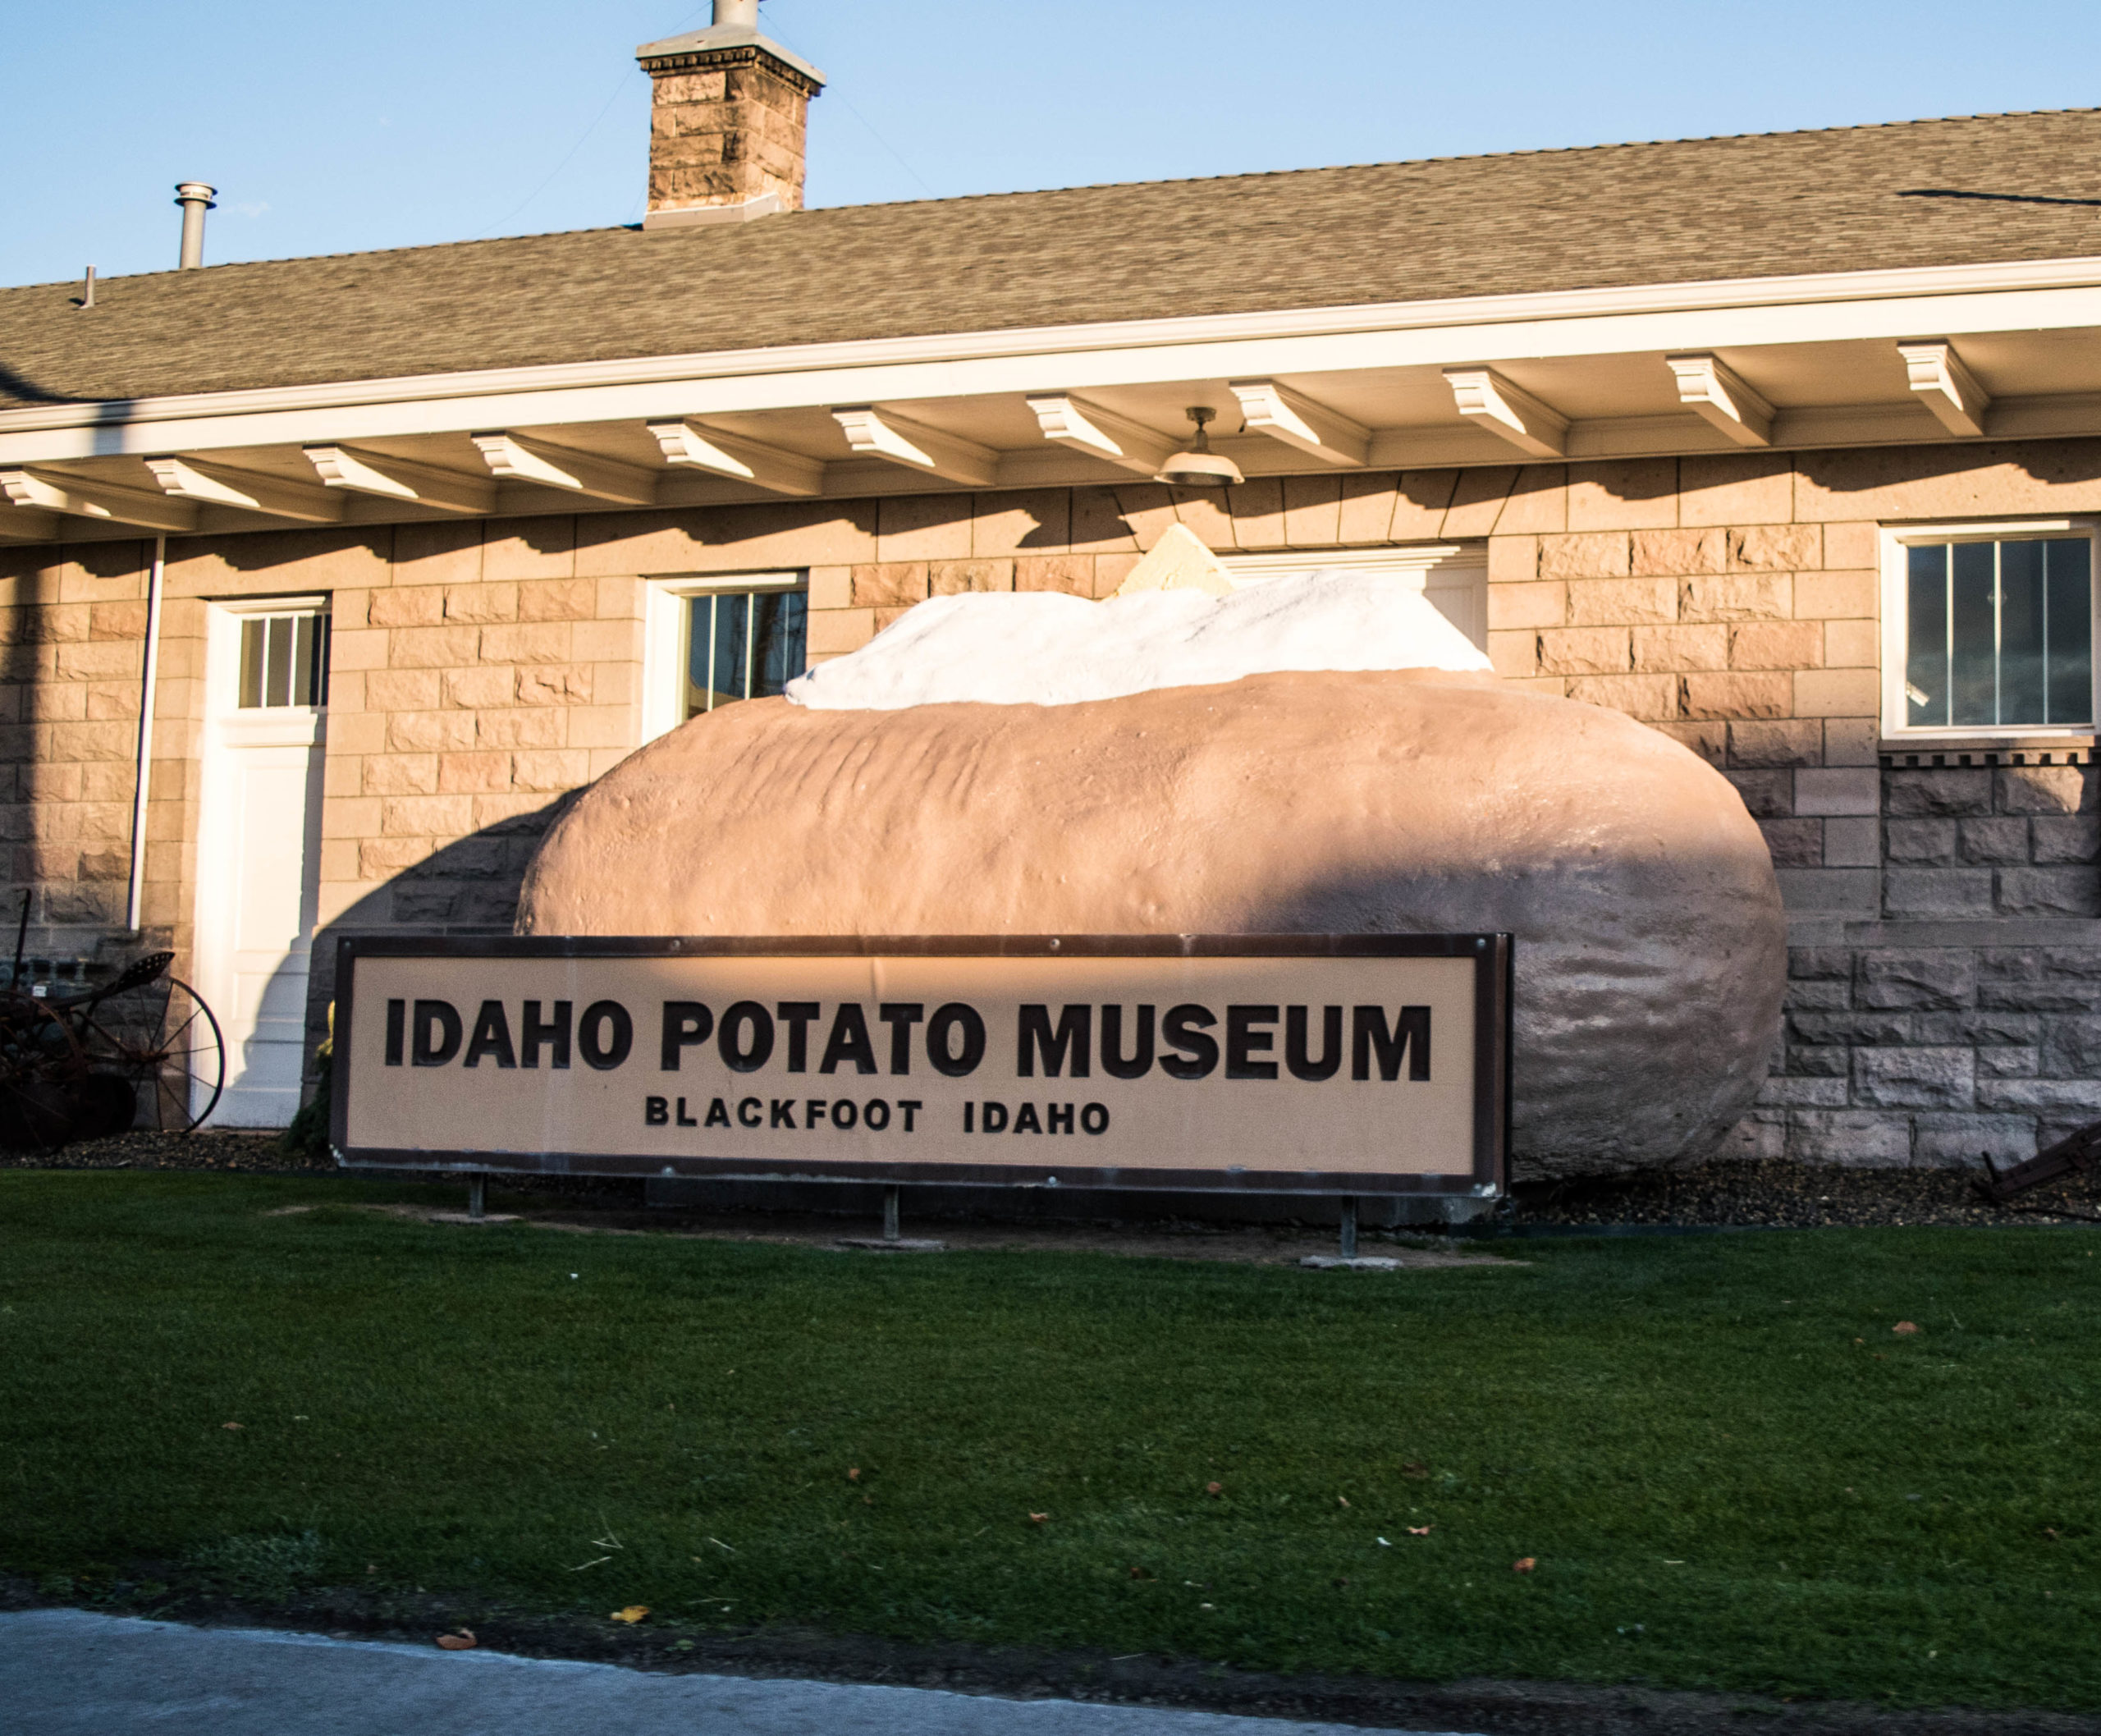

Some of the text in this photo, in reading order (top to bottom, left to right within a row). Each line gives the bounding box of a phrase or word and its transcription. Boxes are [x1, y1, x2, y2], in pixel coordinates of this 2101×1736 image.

[385, 997, 1431, 1082] IDAHO POTATO MUSEUM
[645, 1097, 1110, 1136] BLACKFOOT IDAHO
